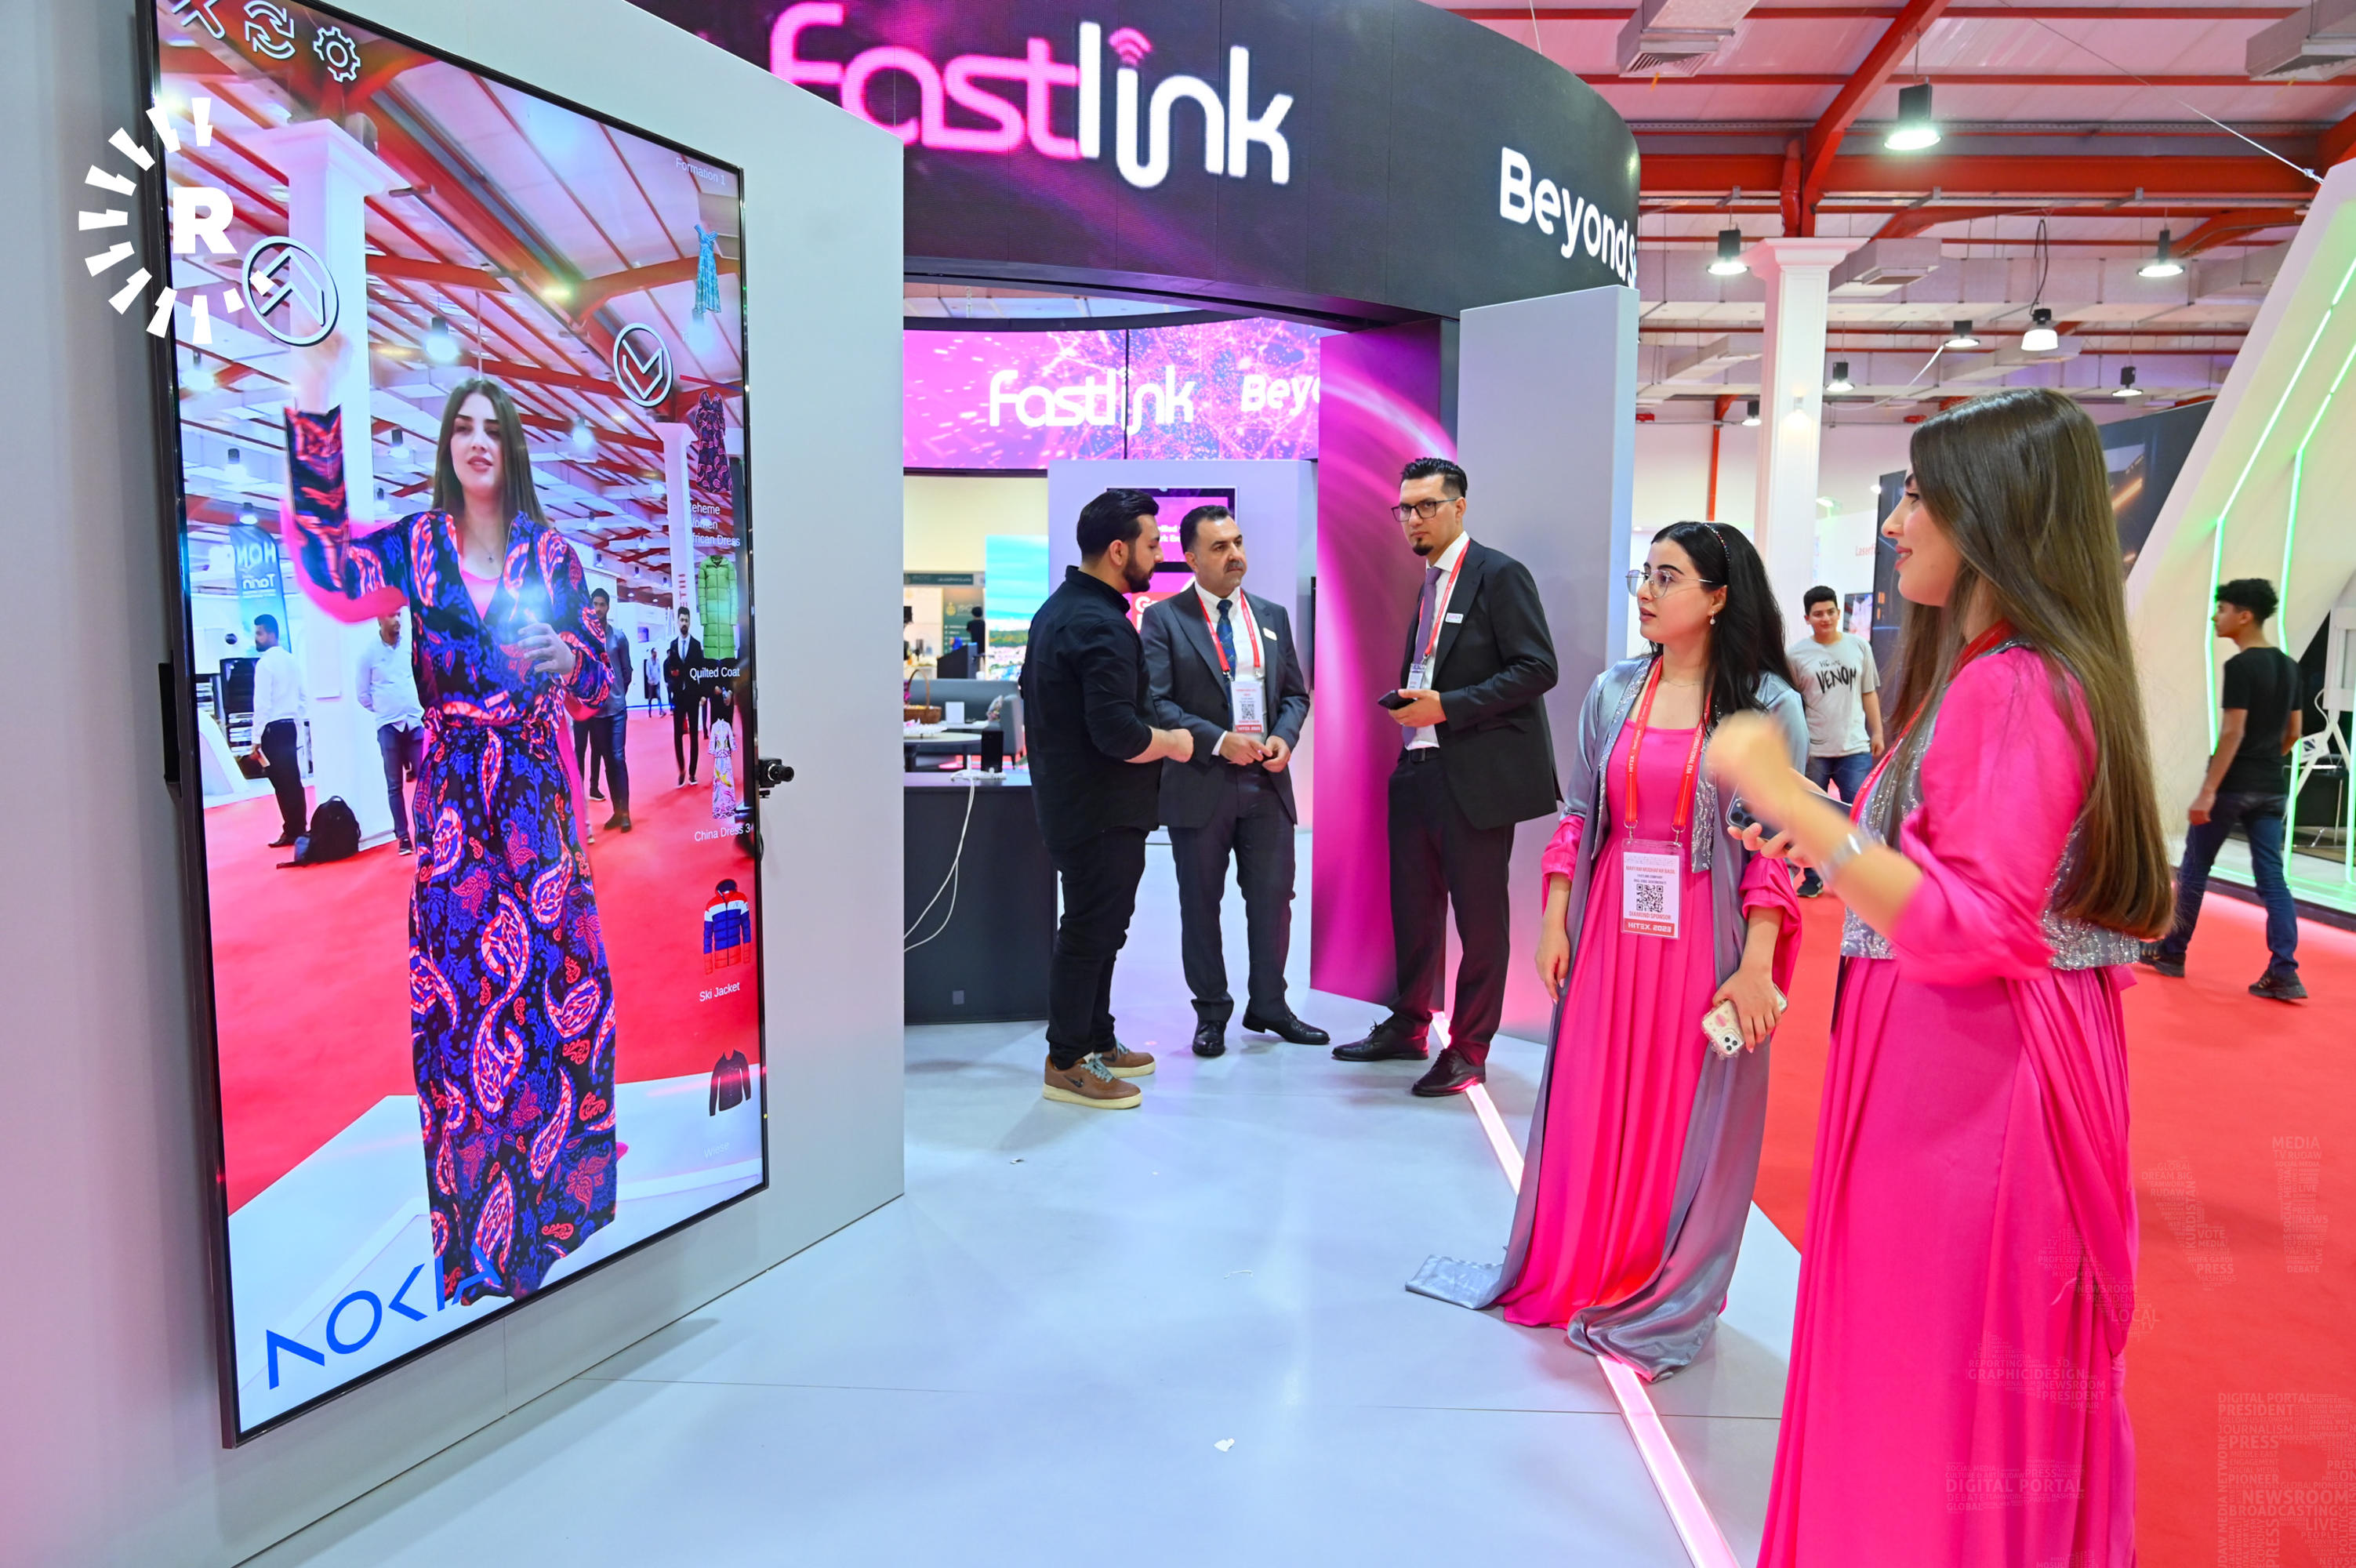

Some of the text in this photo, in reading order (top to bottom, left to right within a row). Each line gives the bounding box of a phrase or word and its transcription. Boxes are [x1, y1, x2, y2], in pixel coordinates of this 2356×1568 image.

[771, 2, 1293, 188] fastlink
[676, 157, 726, 186] Formation 1
[1499, 146, 1628, 281] Beyond
[989, 365, 1196, 436] fastlink
[690, 502, 721, 515] eheme
[692, 517, 718, 530] omen
[692, 532, 741, 547] frican Dress
[689, 666, 740, 681] Quilted Coat
[1816, 666, 1857, 694] VENOM
[695, 822, 751, 841] China Dress 3
[699, 981, 740, 1002] Ski Jacket
[266, 1240, 502, 1390] NOKIA
